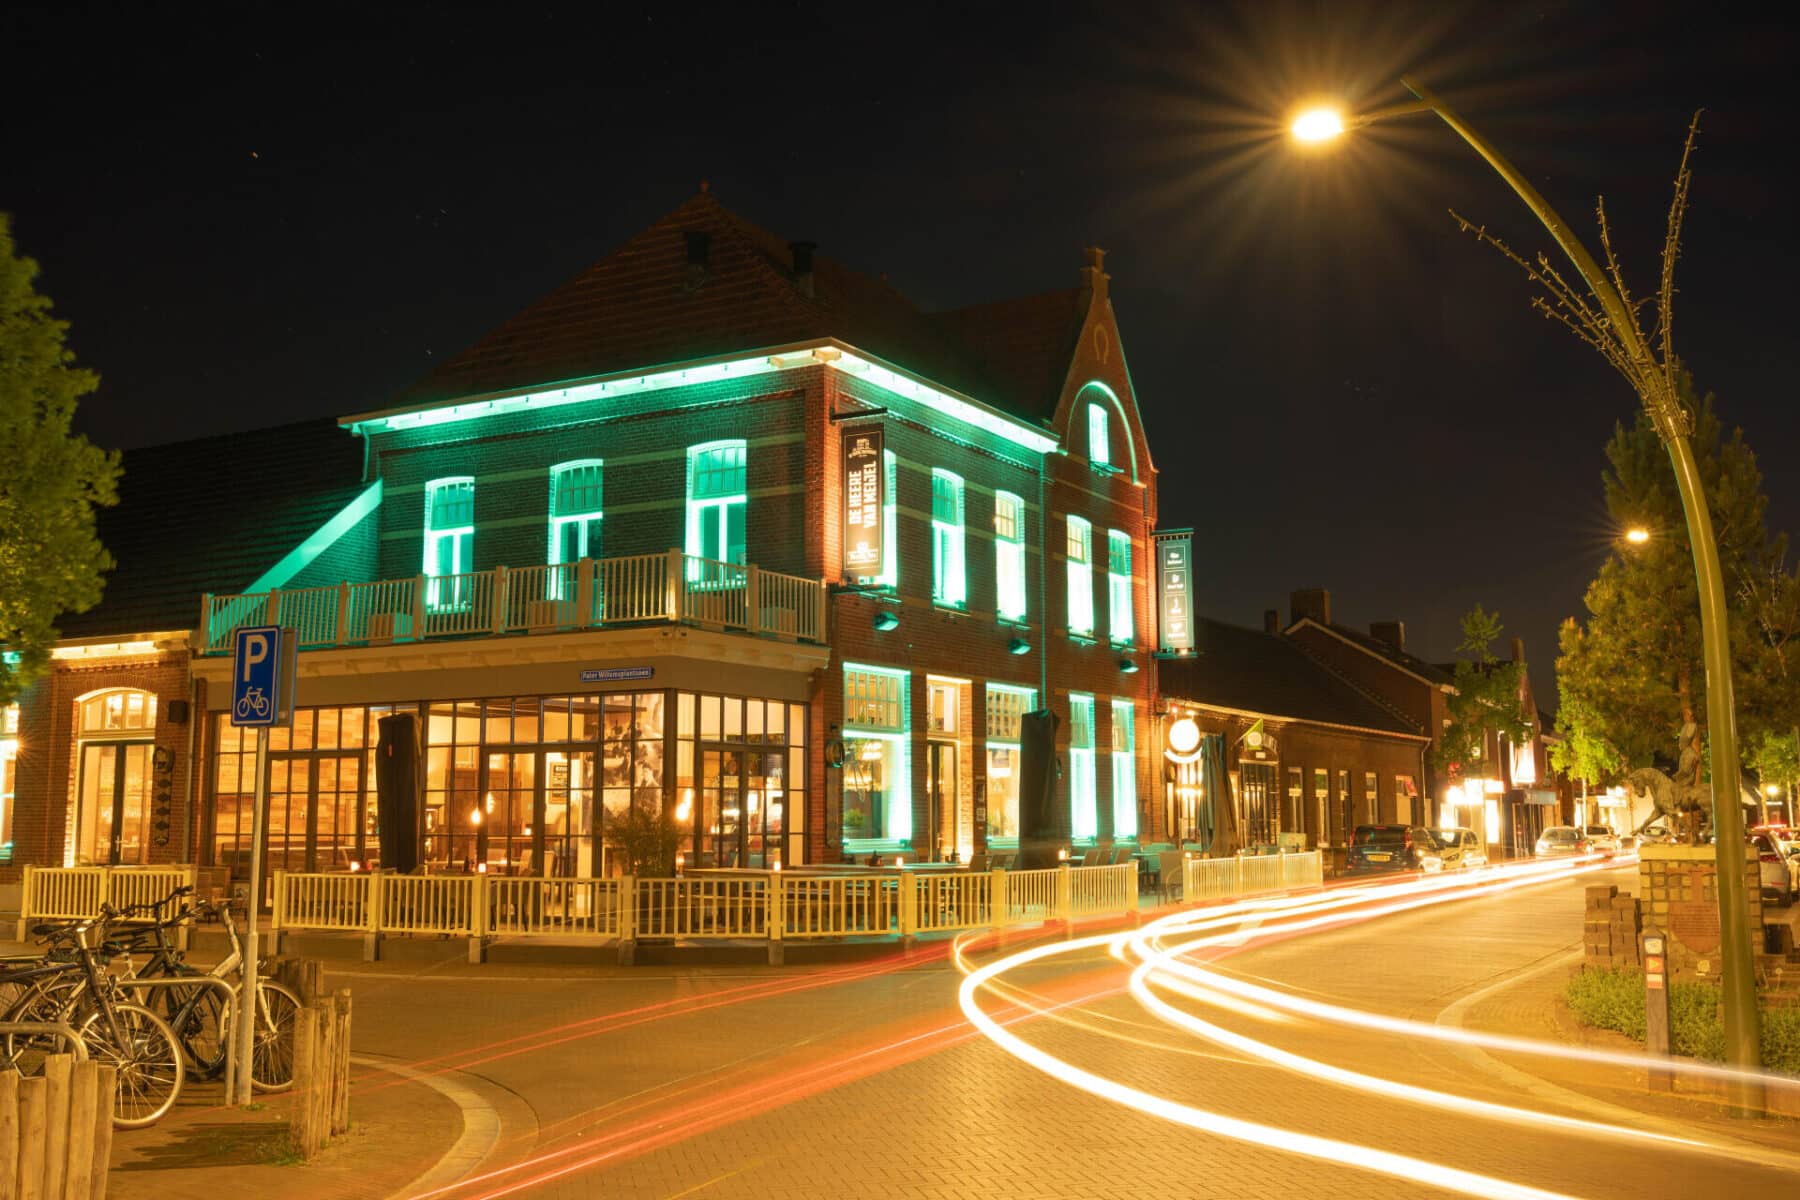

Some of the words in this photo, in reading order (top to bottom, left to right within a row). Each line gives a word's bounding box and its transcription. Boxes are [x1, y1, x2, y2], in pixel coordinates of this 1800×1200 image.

[848, 470, 862, 507] HEERE
[863, 461, 877, 503] MEIJEL
[848, 509, 862, 525] DE
[863, 504, 877, 528] VAN
[243, 634, 268, 682] P
